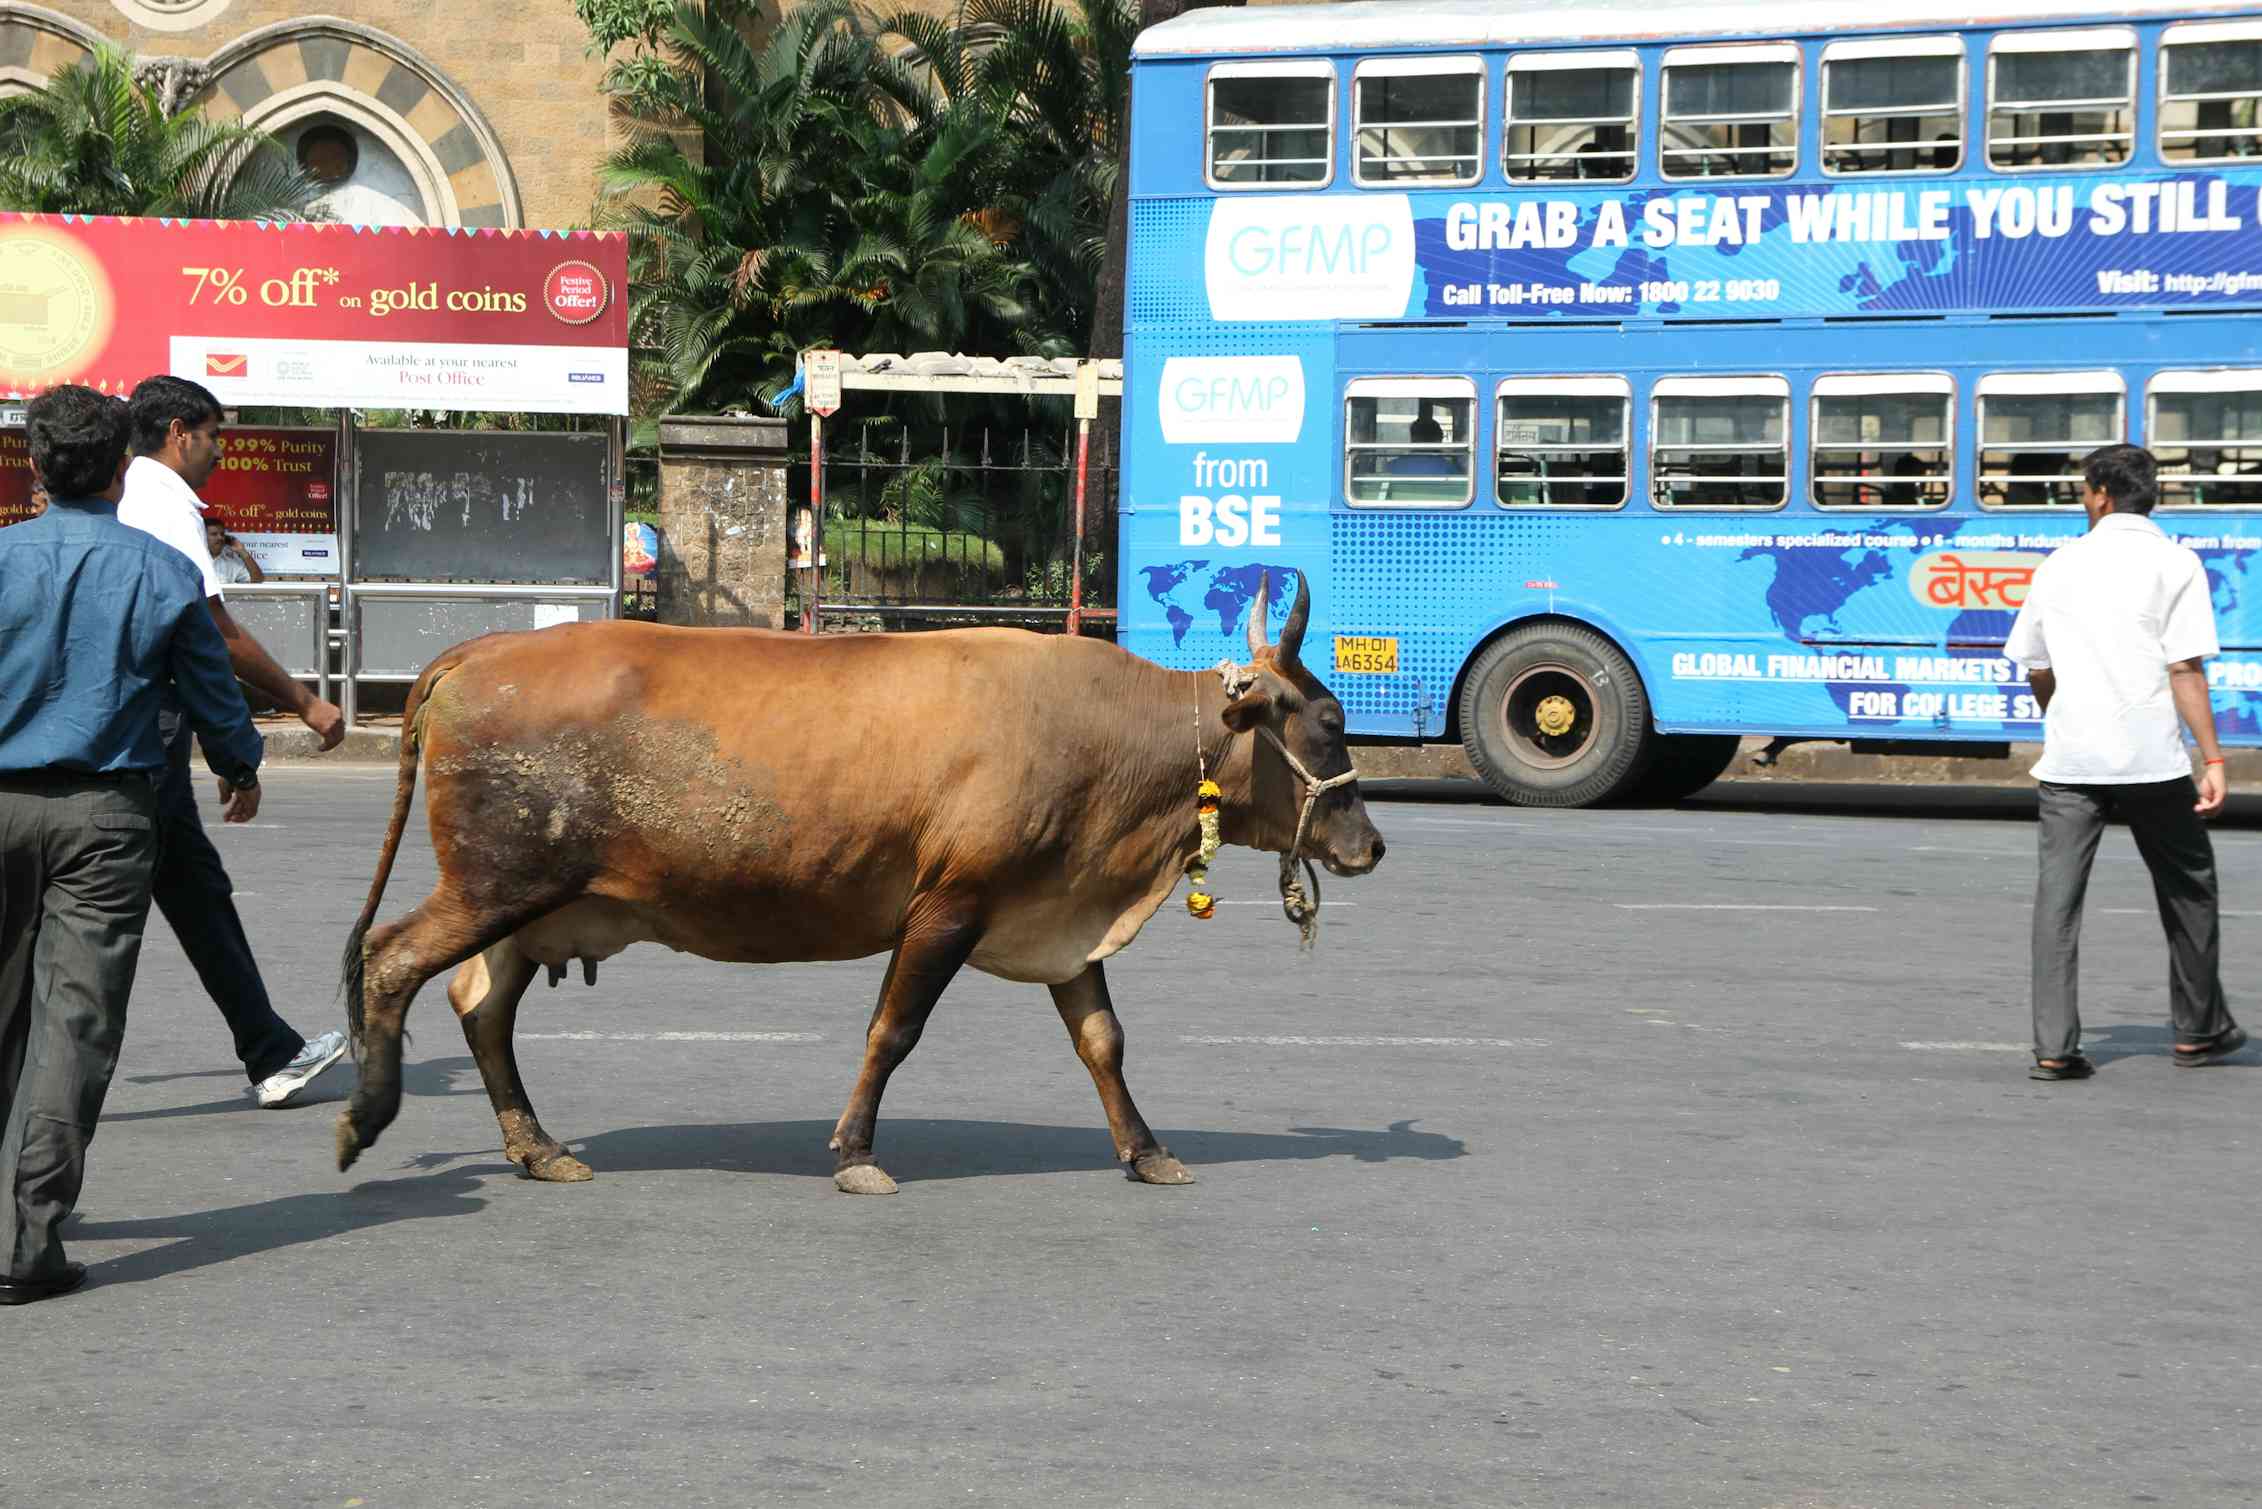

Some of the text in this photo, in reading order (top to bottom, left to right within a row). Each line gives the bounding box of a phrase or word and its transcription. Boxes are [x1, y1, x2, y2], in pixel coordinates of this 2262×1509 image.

[1446, 201, 1578, 250] GRAB
[1591, 200, 1629, 248] A
[1643, 196, 1771, 248] SEAT
[1786, 190, 1950, 243] WHILE
[1966, 185, 2073, 239] YOU
[2089, 180, 2242, 236] STILL
[1229, 223, 1393, 276] GFMP
[182, 267, 248, 305] 7%
[339, 295, 361, 308] on
[369, 281, 439, 316] gold
[446, 286, 527, 312] coins
[560, 276, 593, 286] Festive
[560, 286, 592, 295] Period
[1443, 278, 1780, 305] Call Toll-Free Now: 1800 22 9030
[2097, 270, 2159, 293] Visit:
[555, 295, 597, 308] Offer!
[366, 353, 518, 369] Available at your nearest
[399, 369, 486, 387] Post Office
[1175, 376, 1289, 414] GFMP
[281, 440, 326, 456] Purity
[218, 457, 313, 472] 100% Trust
[1193, 451, 1268, 488] from
[1179, 494, 1281, 547] BSE
[1696, 534, 1774, 547] semesters
[1776, 533, 1861, 549] specialized
[1864, 534, 1918, 548] course
[1955, 534, 2015, 548] months
[1672, 653, 1761, 677] GLOBAL
[1767, 654, 1890, 679] FINANCIAL
[1896, 657, 2011, 682] MARKETS
[1850, 692, 1897, 715] FOR
[1903, 693, 2008, 718] COLLEGE
